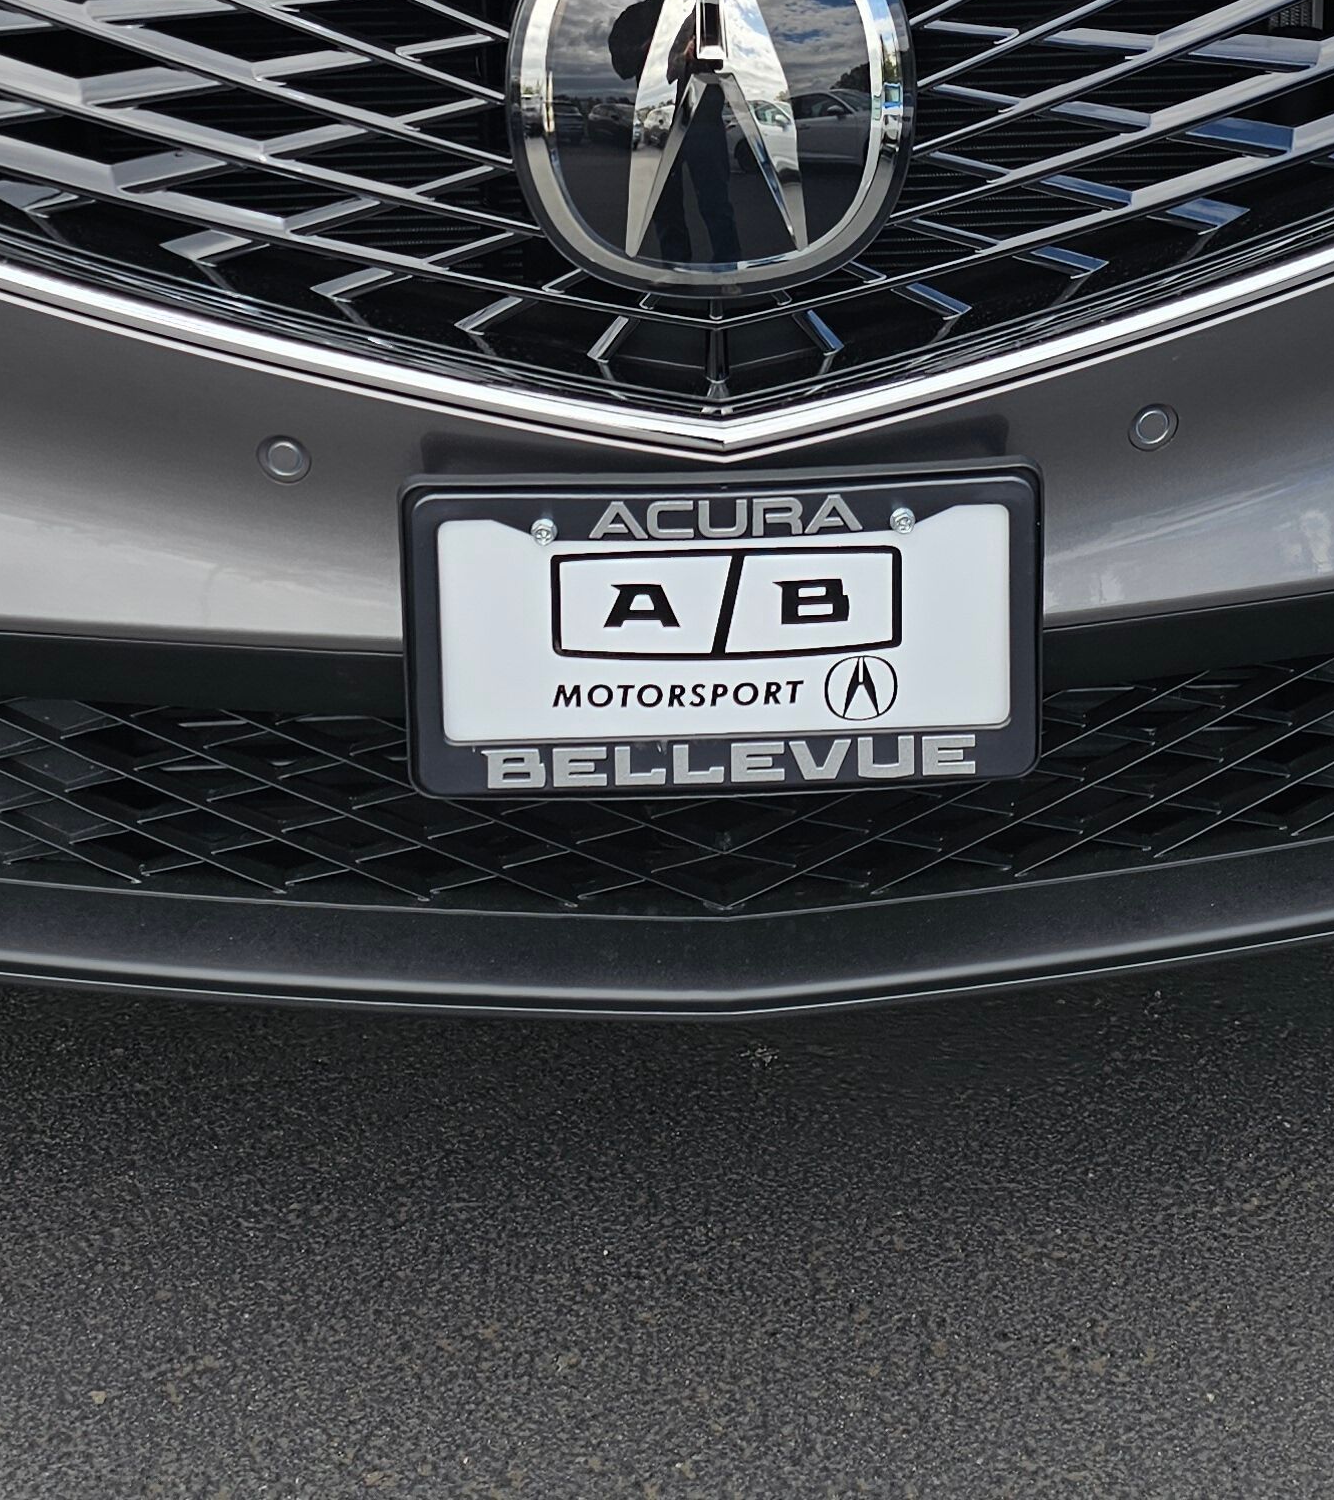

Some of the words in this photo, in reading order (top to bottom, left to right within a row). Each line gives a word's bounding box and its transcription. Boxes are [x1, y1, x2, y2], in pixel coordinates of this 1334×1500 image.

[588, 493, 864, 540] ACURA
[603, 583, 681, 629] A
[772, 578, 850, 626] B
[552, 679, 805, 709] MOTORSPORT
[480, 733, 976, 790] BELLEVUE
